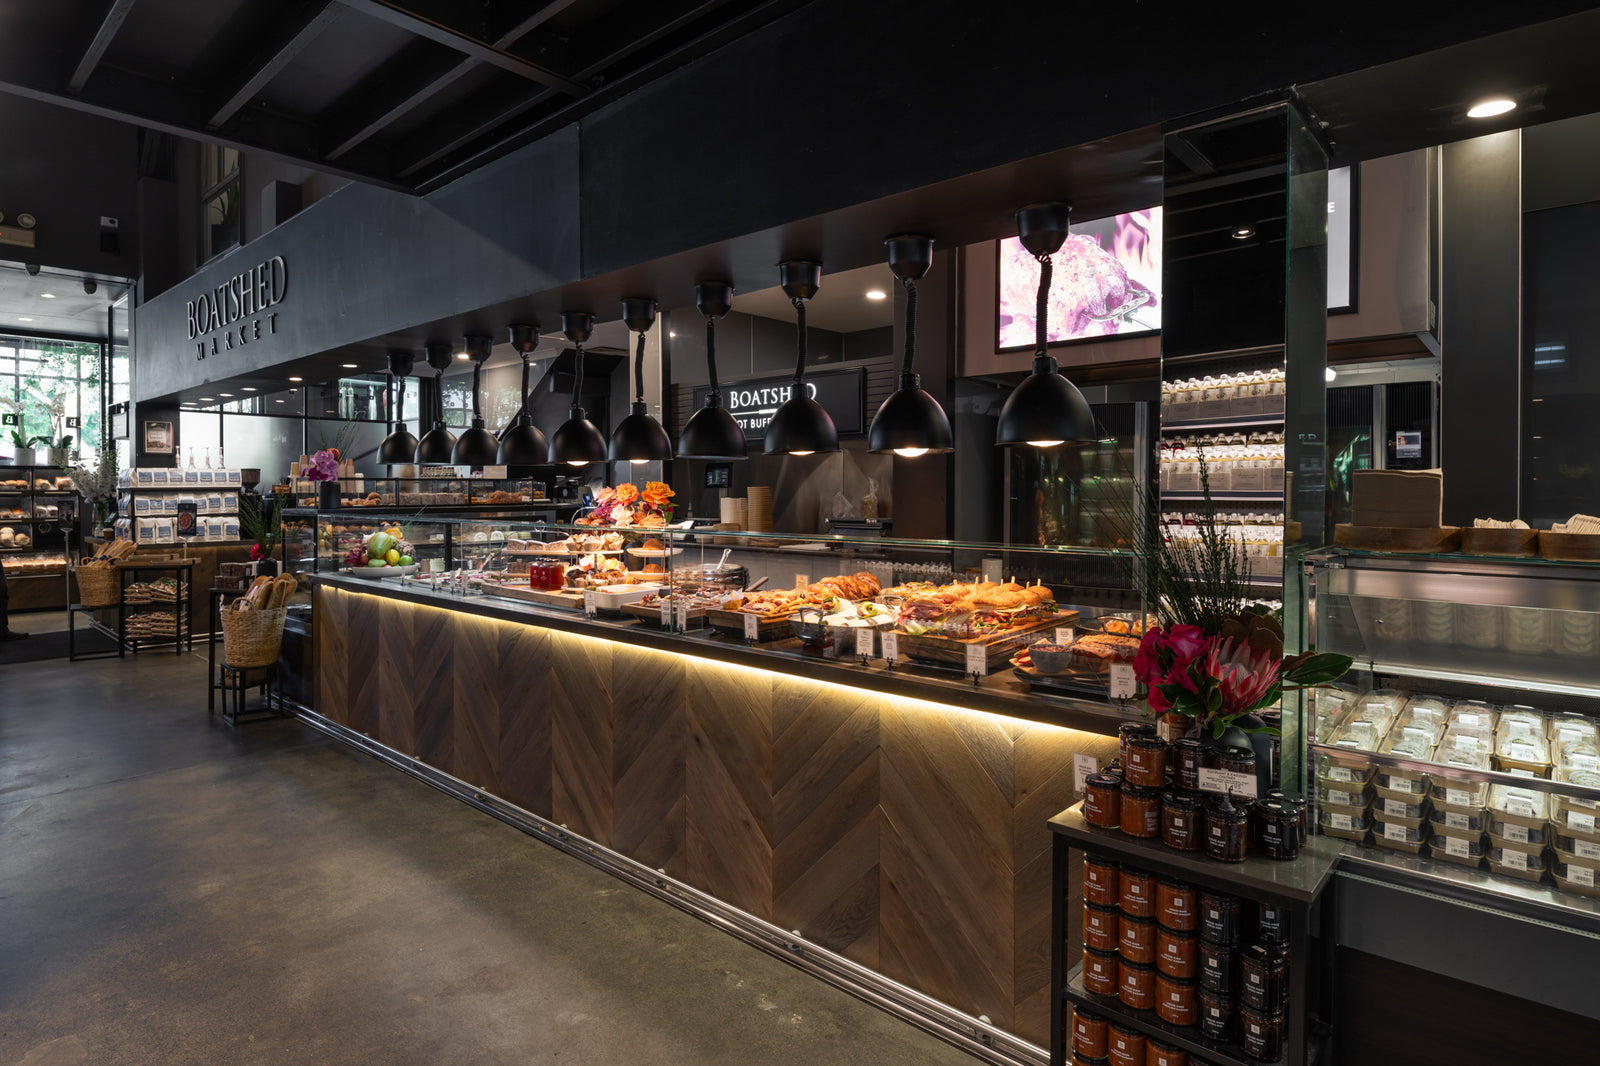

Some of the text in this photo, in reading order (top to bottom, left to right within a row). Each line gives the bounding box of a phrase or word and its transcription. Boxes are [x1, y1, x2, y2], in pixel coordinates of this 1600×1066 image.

[187, 255, 287, 340] BOATSHED
[196, 313, 277, 360] MARKET
[730, 383, 816, 408] BOATSHD
[737, 418, 772, 429] OT BUFF
